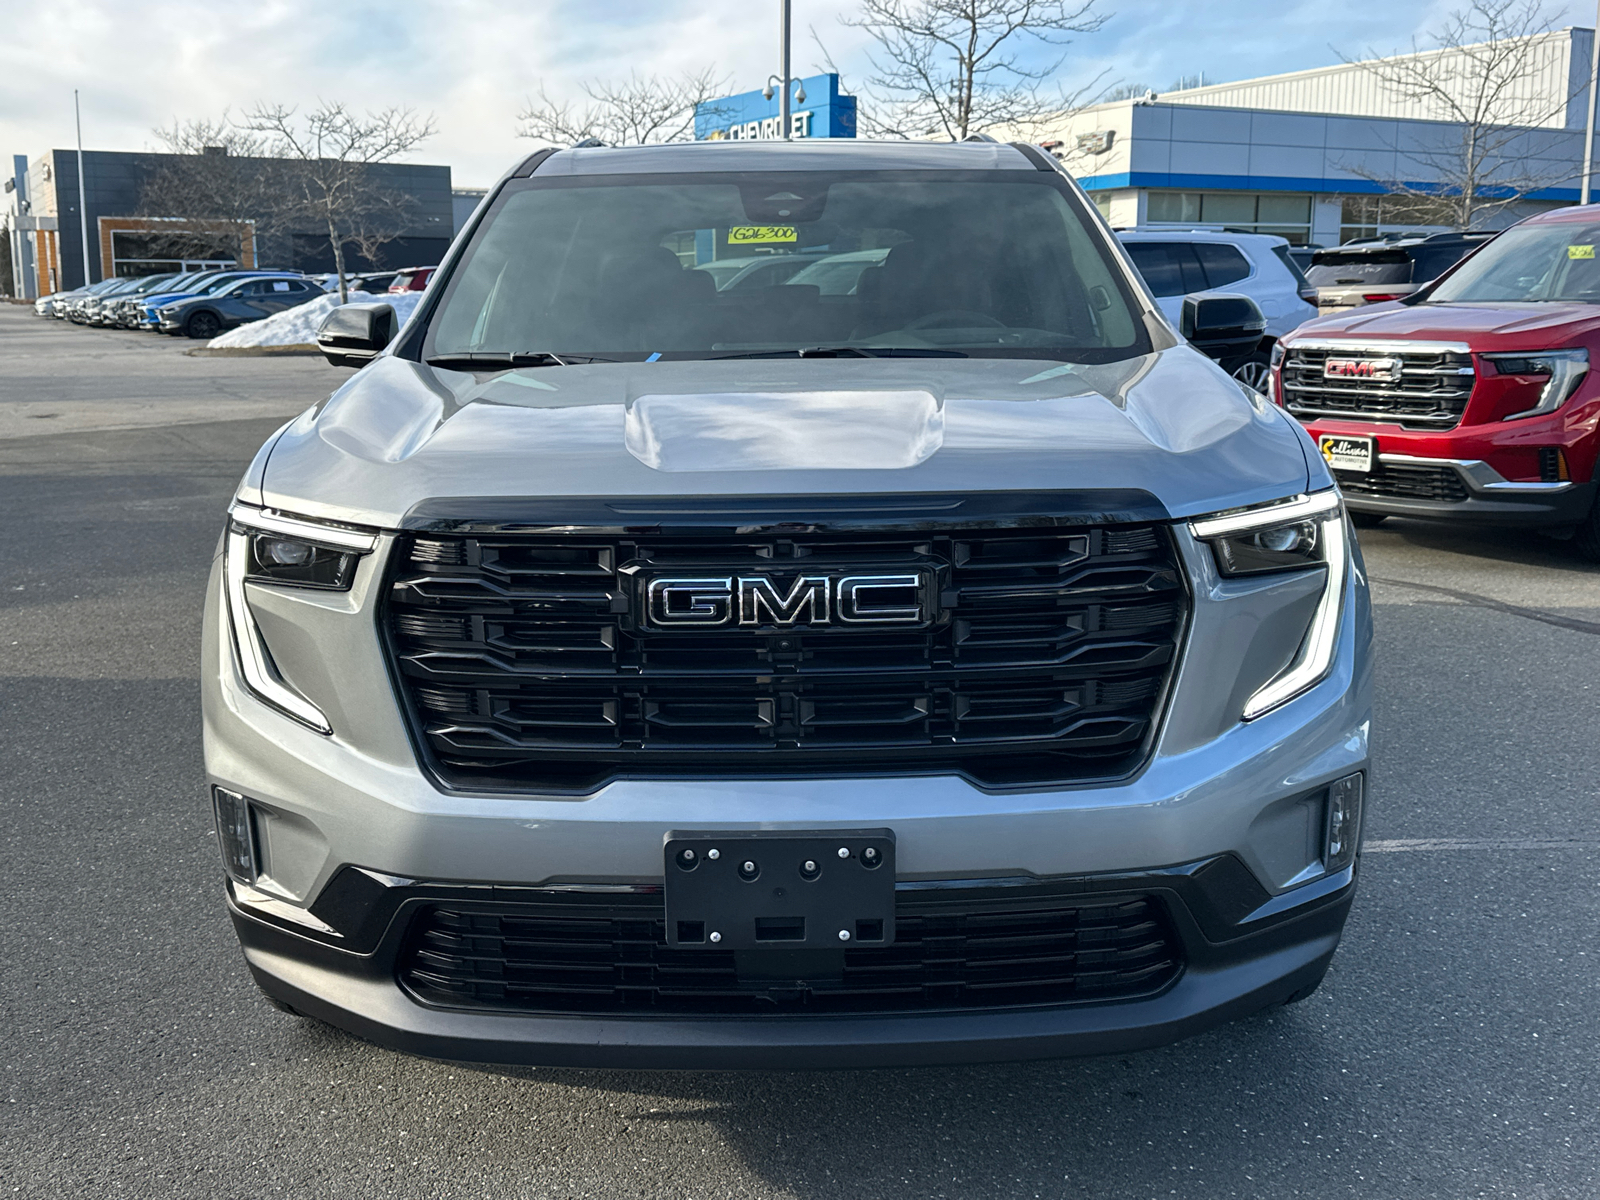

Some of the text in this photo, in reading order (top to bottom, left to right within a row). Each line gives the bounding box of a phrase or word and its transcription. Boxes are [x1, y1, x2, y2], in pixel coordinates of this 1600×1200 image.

[730, 110, 812, 140] CHEVROET
[733, 227, 794, 241] G26-300
[1322, 440, 1369, 462] Sullivan
[1334, 456, 1368, 465] AUTOMOTIVE
[648, 574, 921, 625] GMC
